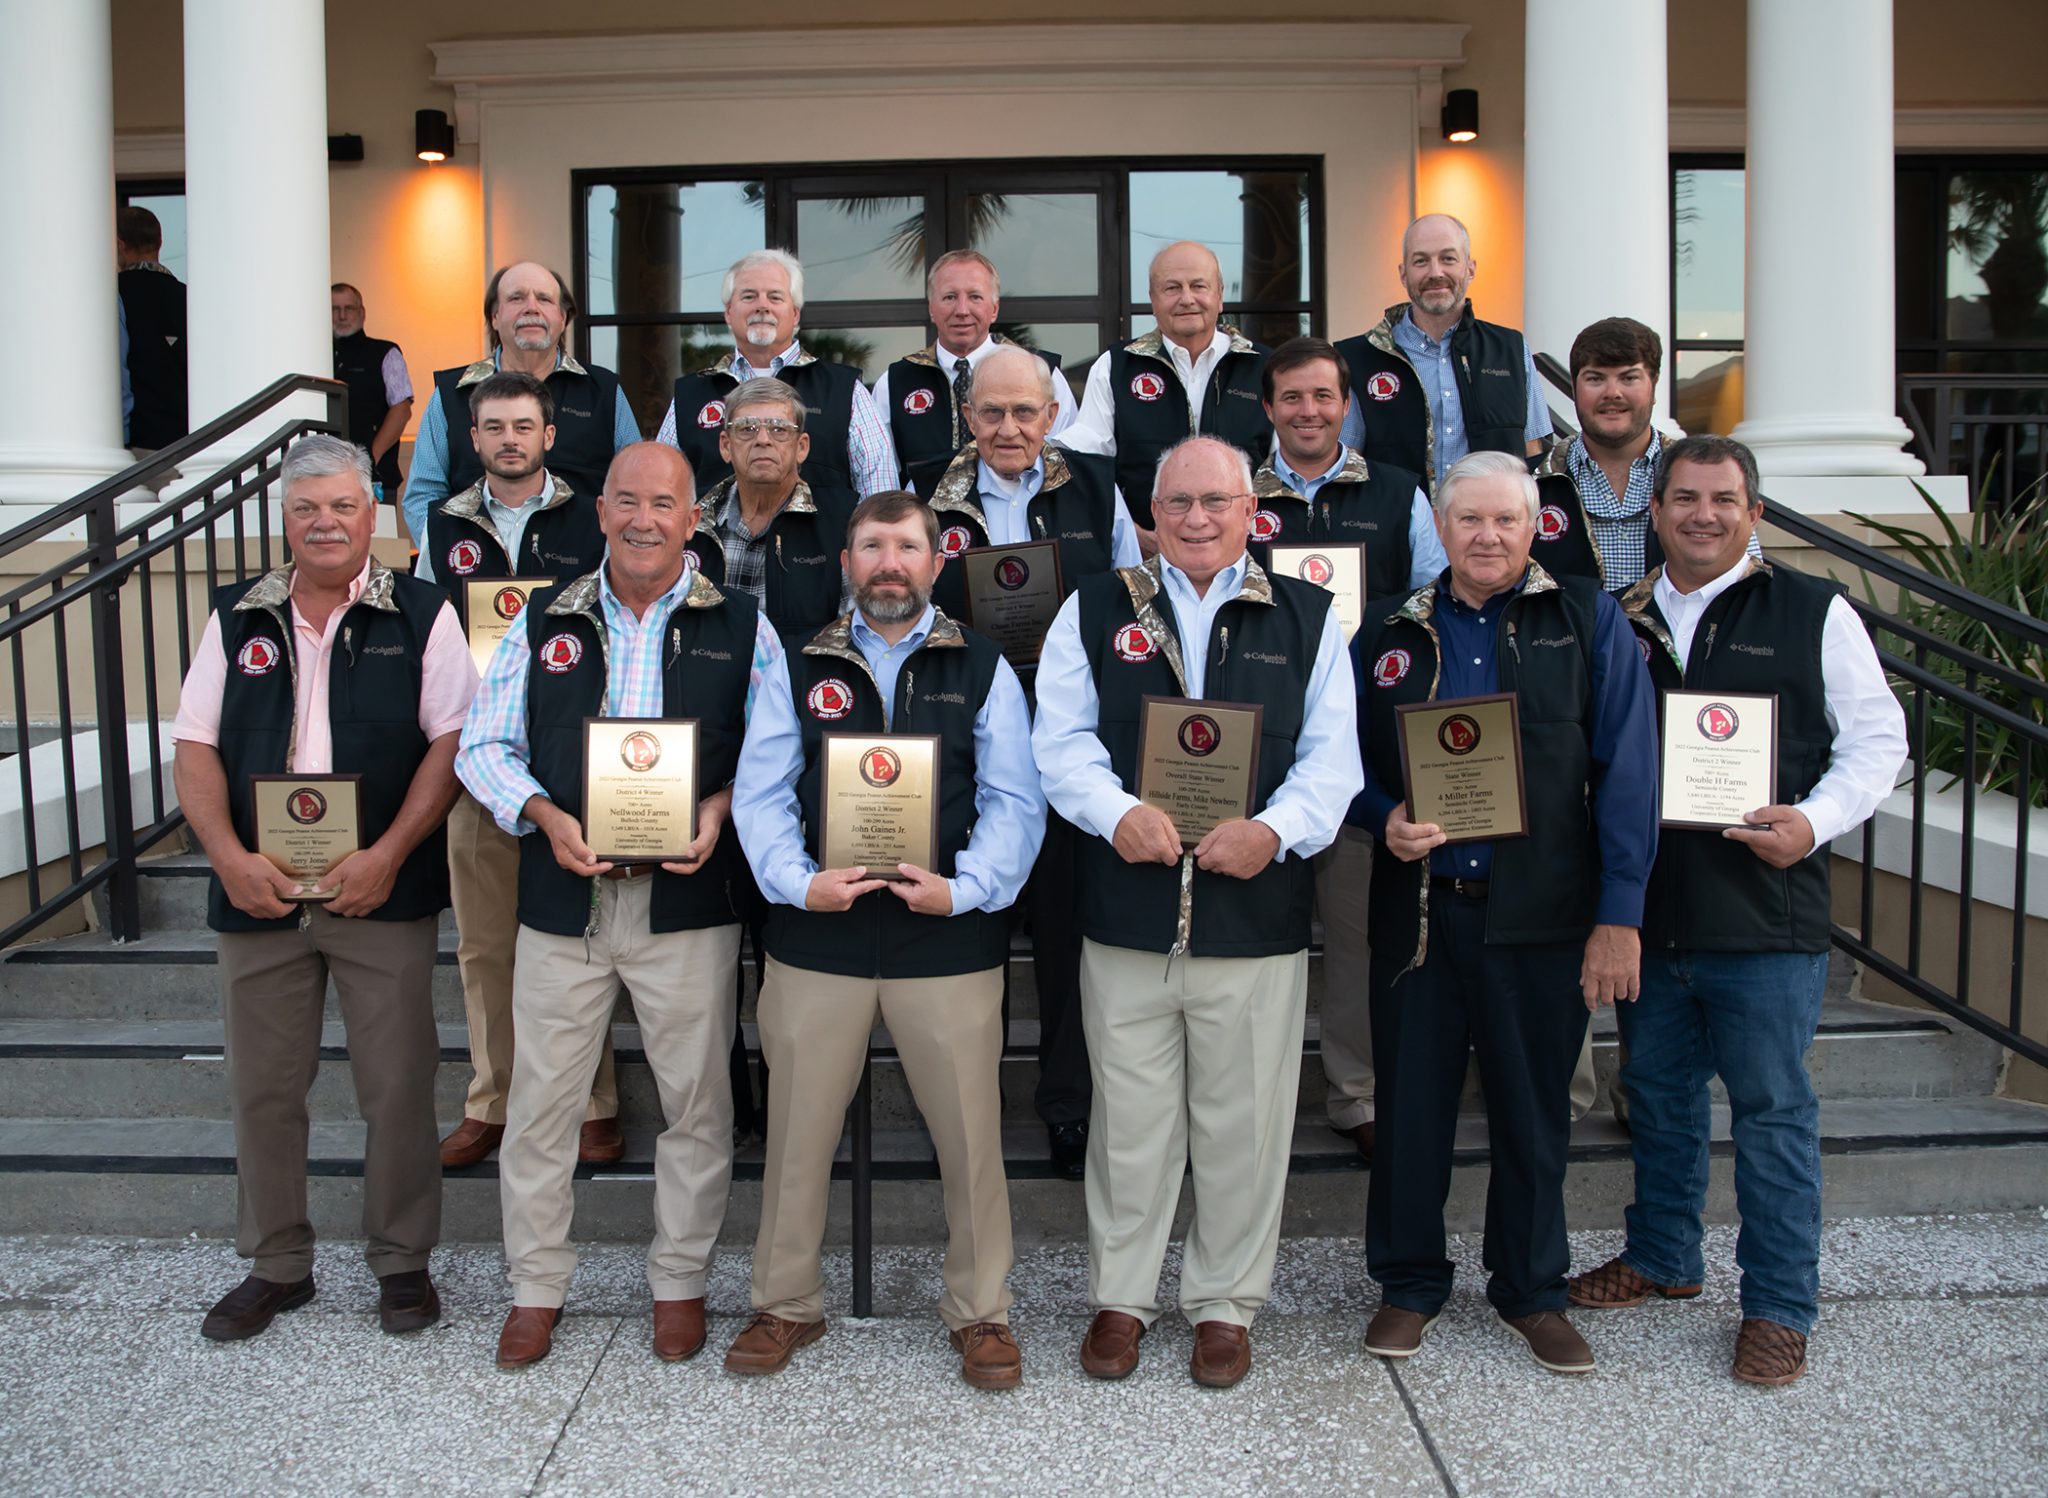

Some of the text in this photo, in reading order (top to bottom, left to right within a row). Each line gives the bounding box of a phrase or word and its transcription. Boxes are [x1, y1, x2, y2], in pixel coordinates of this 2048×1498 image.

[1251, 652, 1286, 662] Columbia
[1686, 775, 1748, 787] Double H Farms
[1149, 790, 1171, 800] Hillside
[1193, 795, 1209, 803] Mike
[1210, 796, 1238, 808] Newberry
[1444, 792, 1468, 801] Miller
[1469, 790, 1493, 799] Farms
[610, 808, 670, 817] Nellwood Farms
[851, 825, 906, 834] John Gaines Jr.
[290, 857, 307, 865] Jerry
